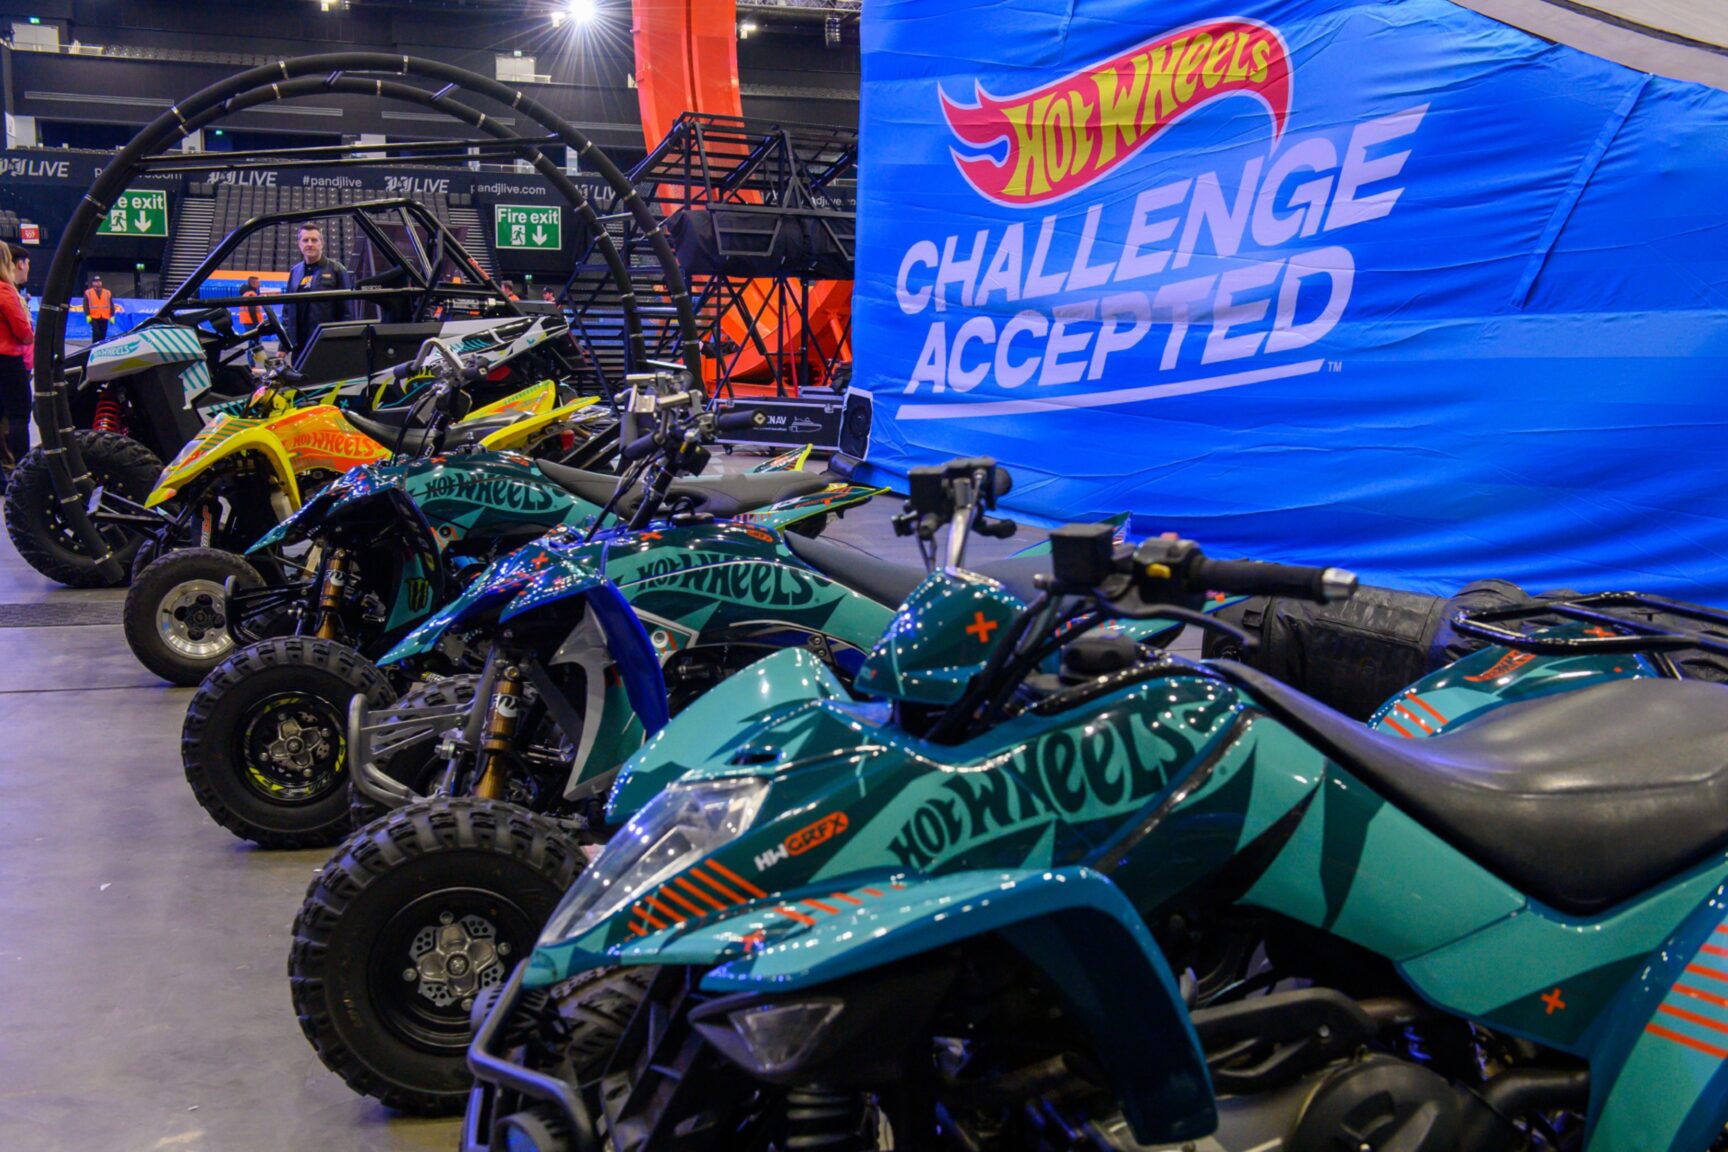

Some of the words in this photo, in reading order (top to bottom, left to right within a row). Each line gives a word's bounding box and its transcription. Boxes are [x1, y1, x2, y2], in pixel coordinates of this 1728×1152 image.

[28, 160, 70, 178] LIVE
[239, 171, 278, 187] LIVE
[303, 175, 363, 188] #pandjlive
[414, 178, 450, 193] LIVE
[593, 185, 616, 200] LIV
[131, 194, 164, 210] exit
[896, 102, 1431, 315] CHALLENGE
[498, 208, 527, 223] Fire
[530, 209, 559, 224] exit
[903, 246, 1356, 395] ACCEPTED
